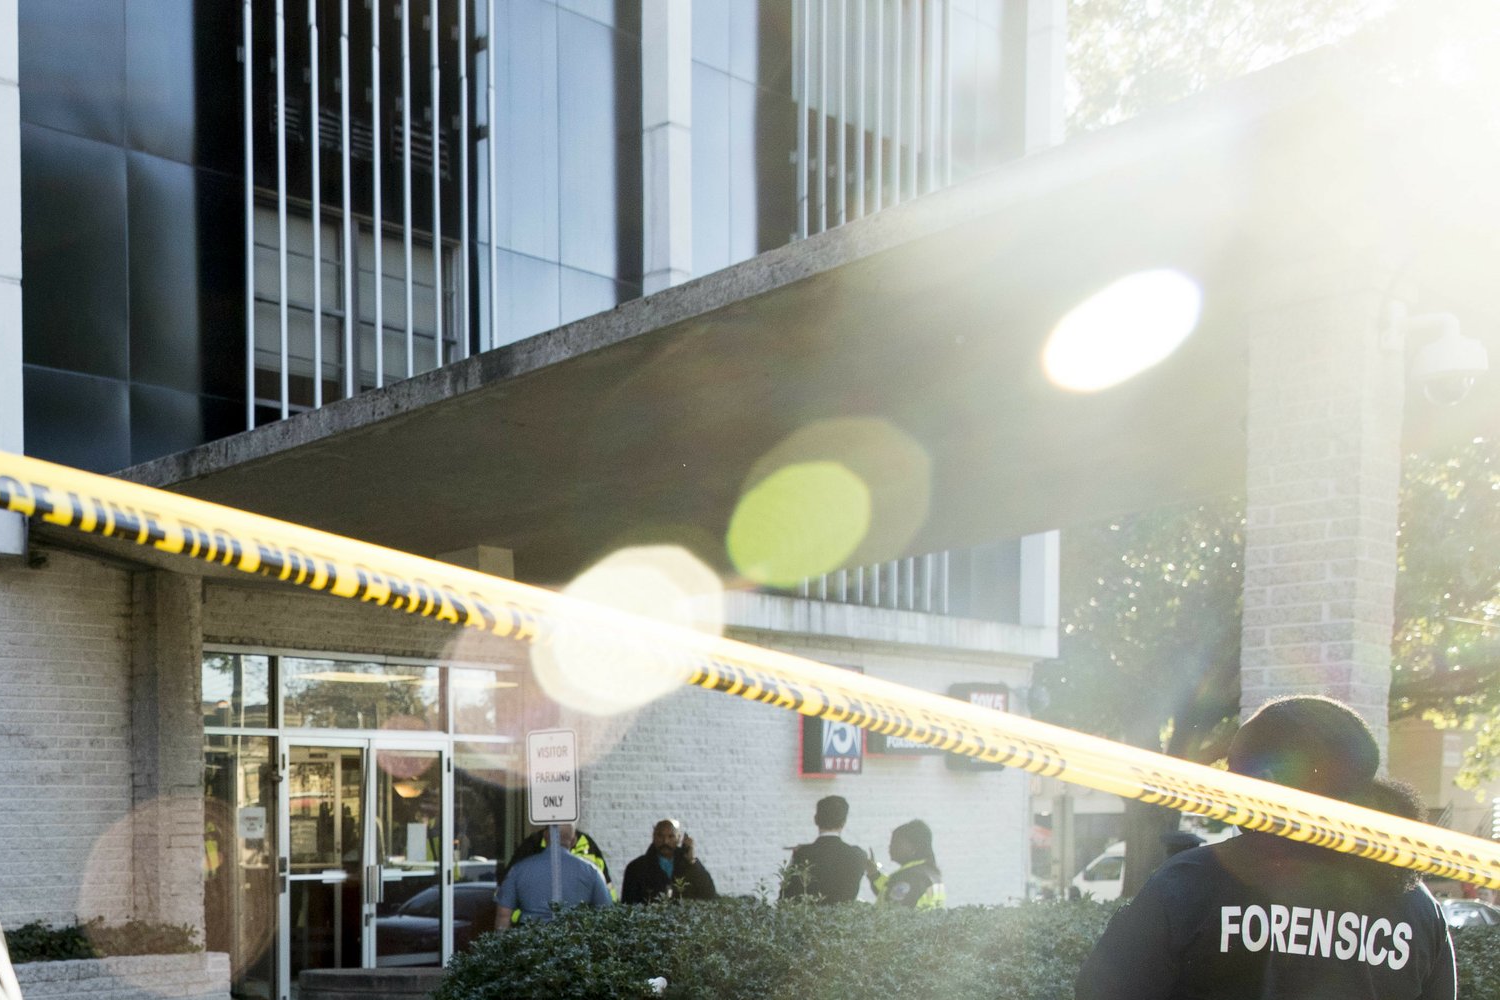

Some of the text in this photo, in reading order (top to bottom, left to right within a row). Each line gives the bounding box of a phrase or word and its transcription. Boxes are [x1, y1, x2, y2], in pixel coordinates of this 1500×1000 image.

[536, 745, 569, 759] VISITOR
[824, 757, 860, 771] WTTG
[535, 771, 570, 783] PARKING
[542, 795, 564, 808] ONLY
[1219, 904, 1413, 970] FORENSICS
